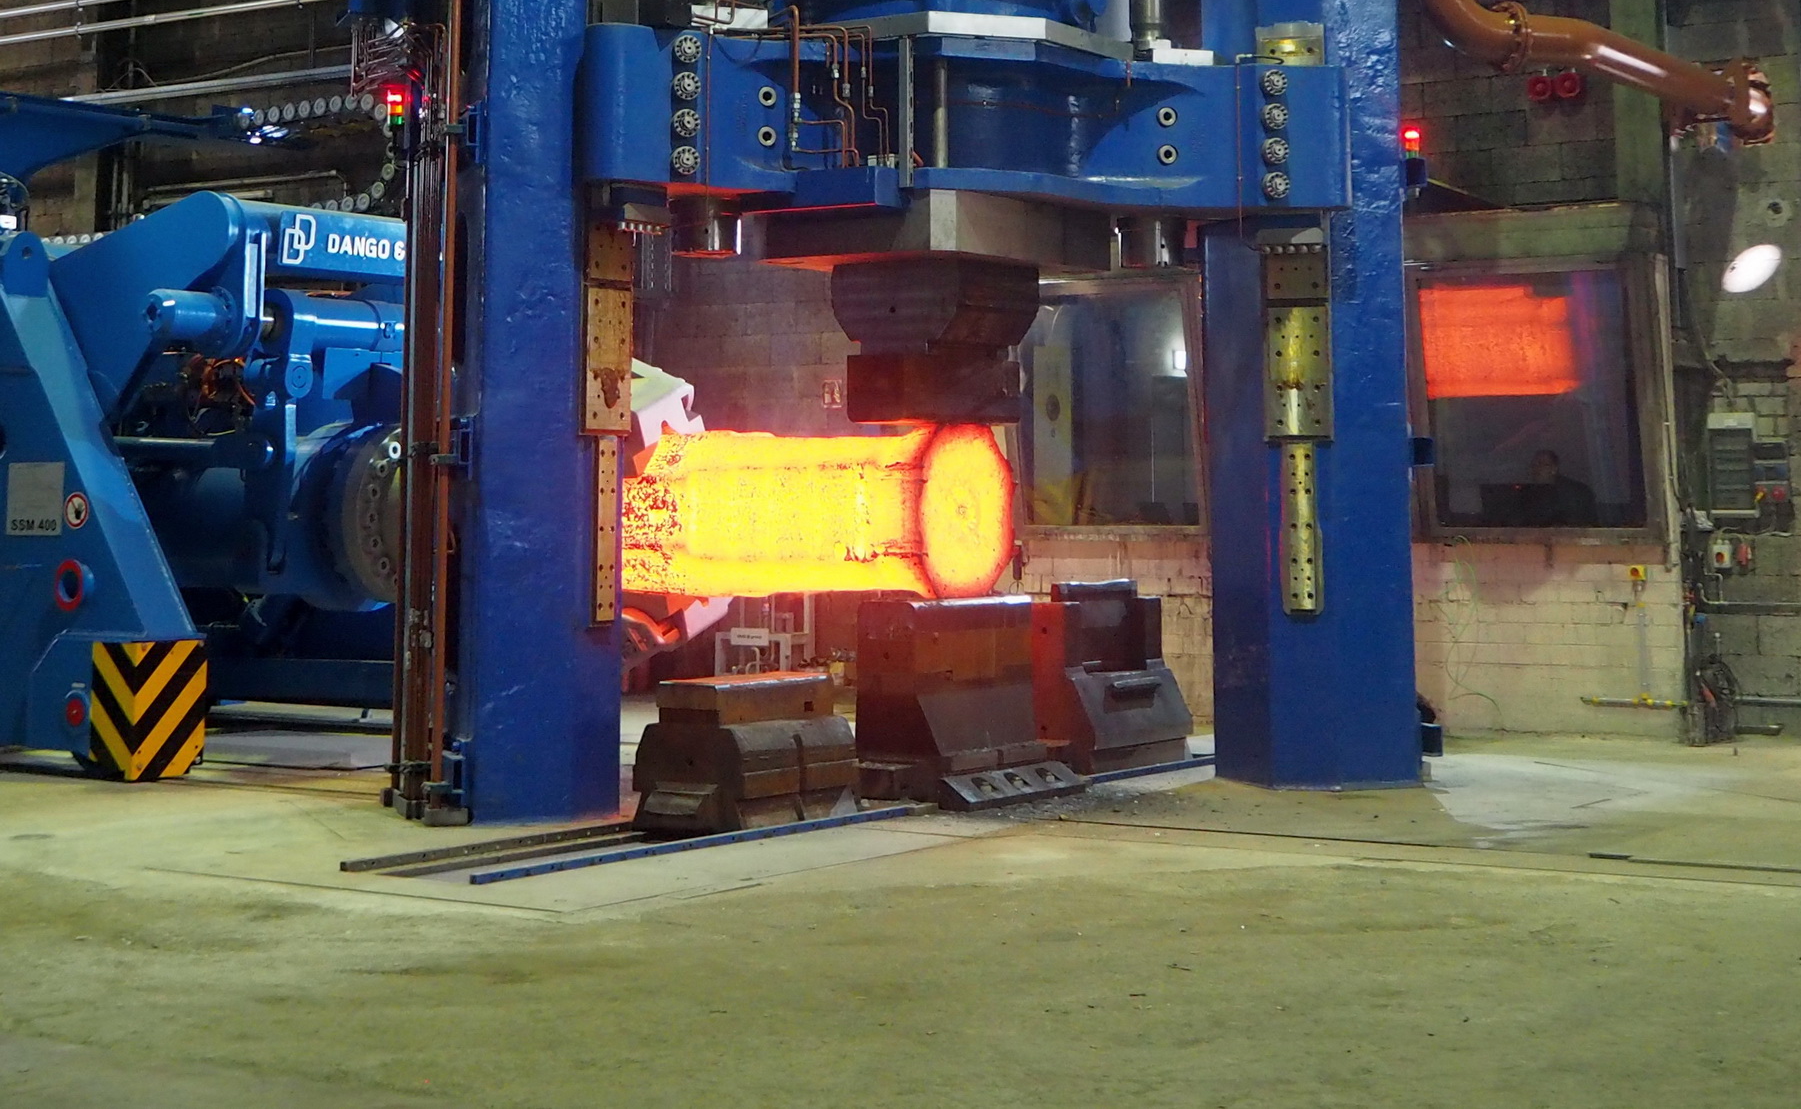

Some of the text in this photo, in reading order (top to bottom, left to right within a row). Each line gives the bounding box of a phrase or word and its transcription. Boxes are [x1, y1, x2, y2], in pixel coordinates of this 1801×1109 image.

[327, 233, 391, 260] DANGO
[11, 518, 57, 531] SSM 400
